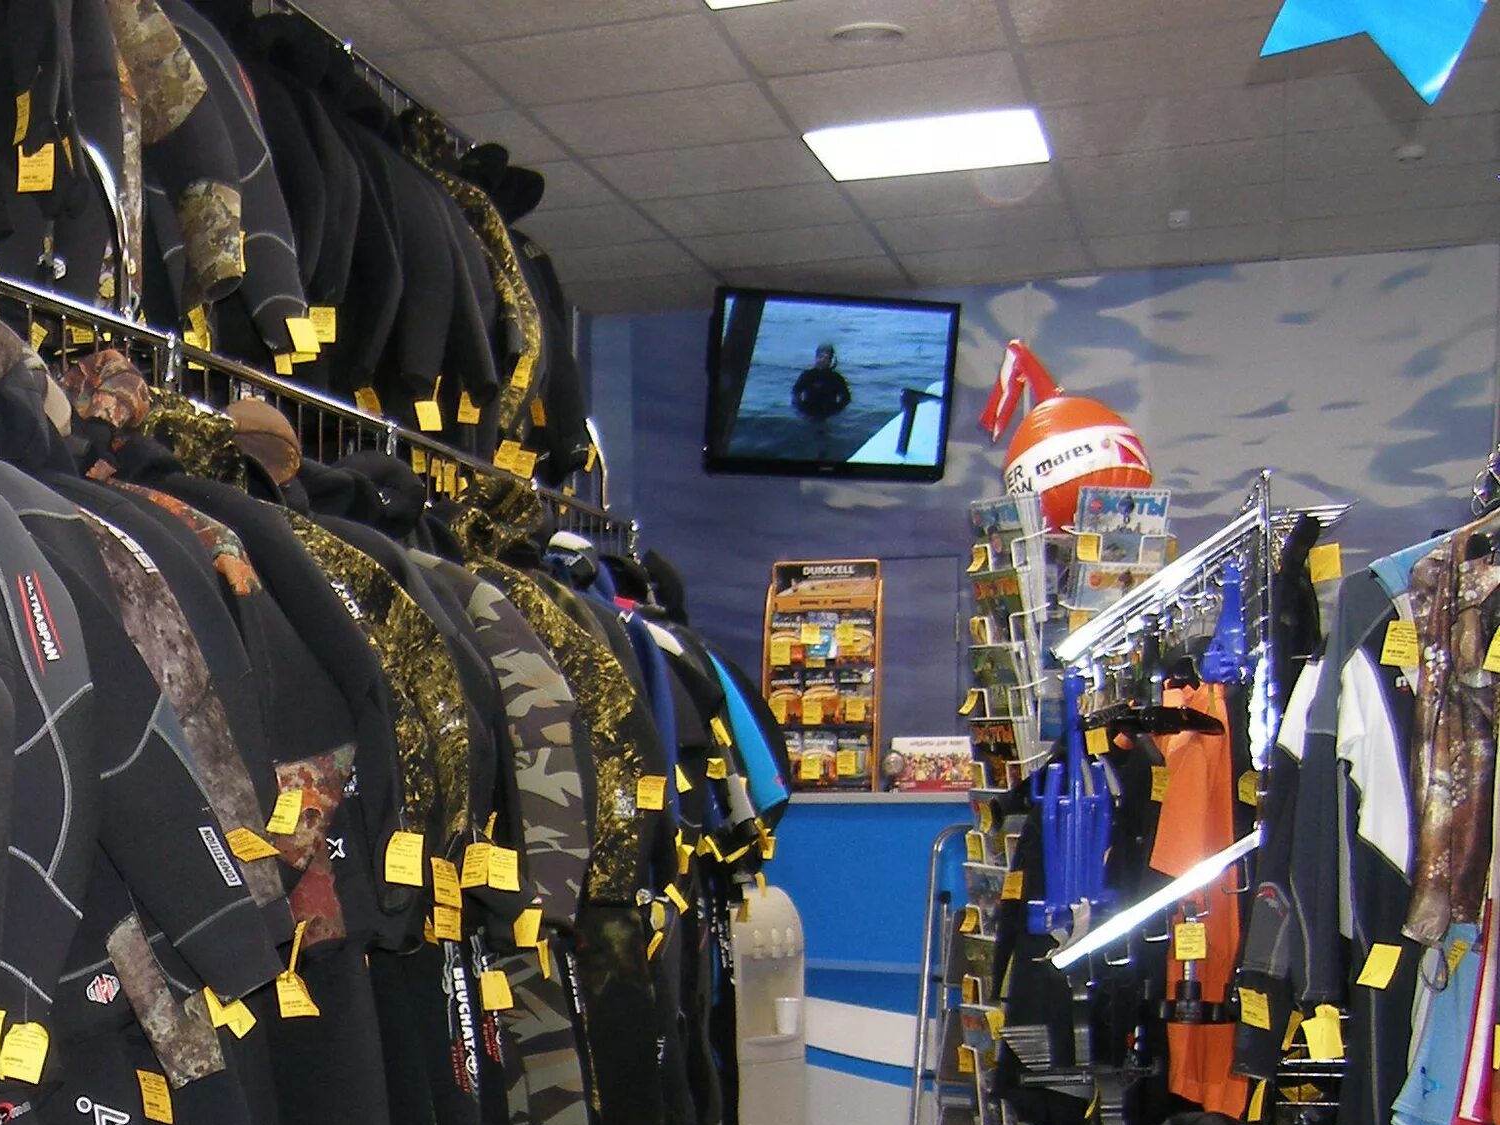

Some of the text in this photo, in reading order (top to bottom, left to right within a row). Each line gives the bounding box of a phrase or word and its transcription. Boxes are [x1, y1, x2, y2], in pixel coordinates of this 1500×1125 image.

[1035, 442, 1093, 477] mares
[802, 565, 856, 576] DURACELL
[202, 828, 238, 884] COMPETITION
[452, 966, 476, 1050] BEUCHAT
